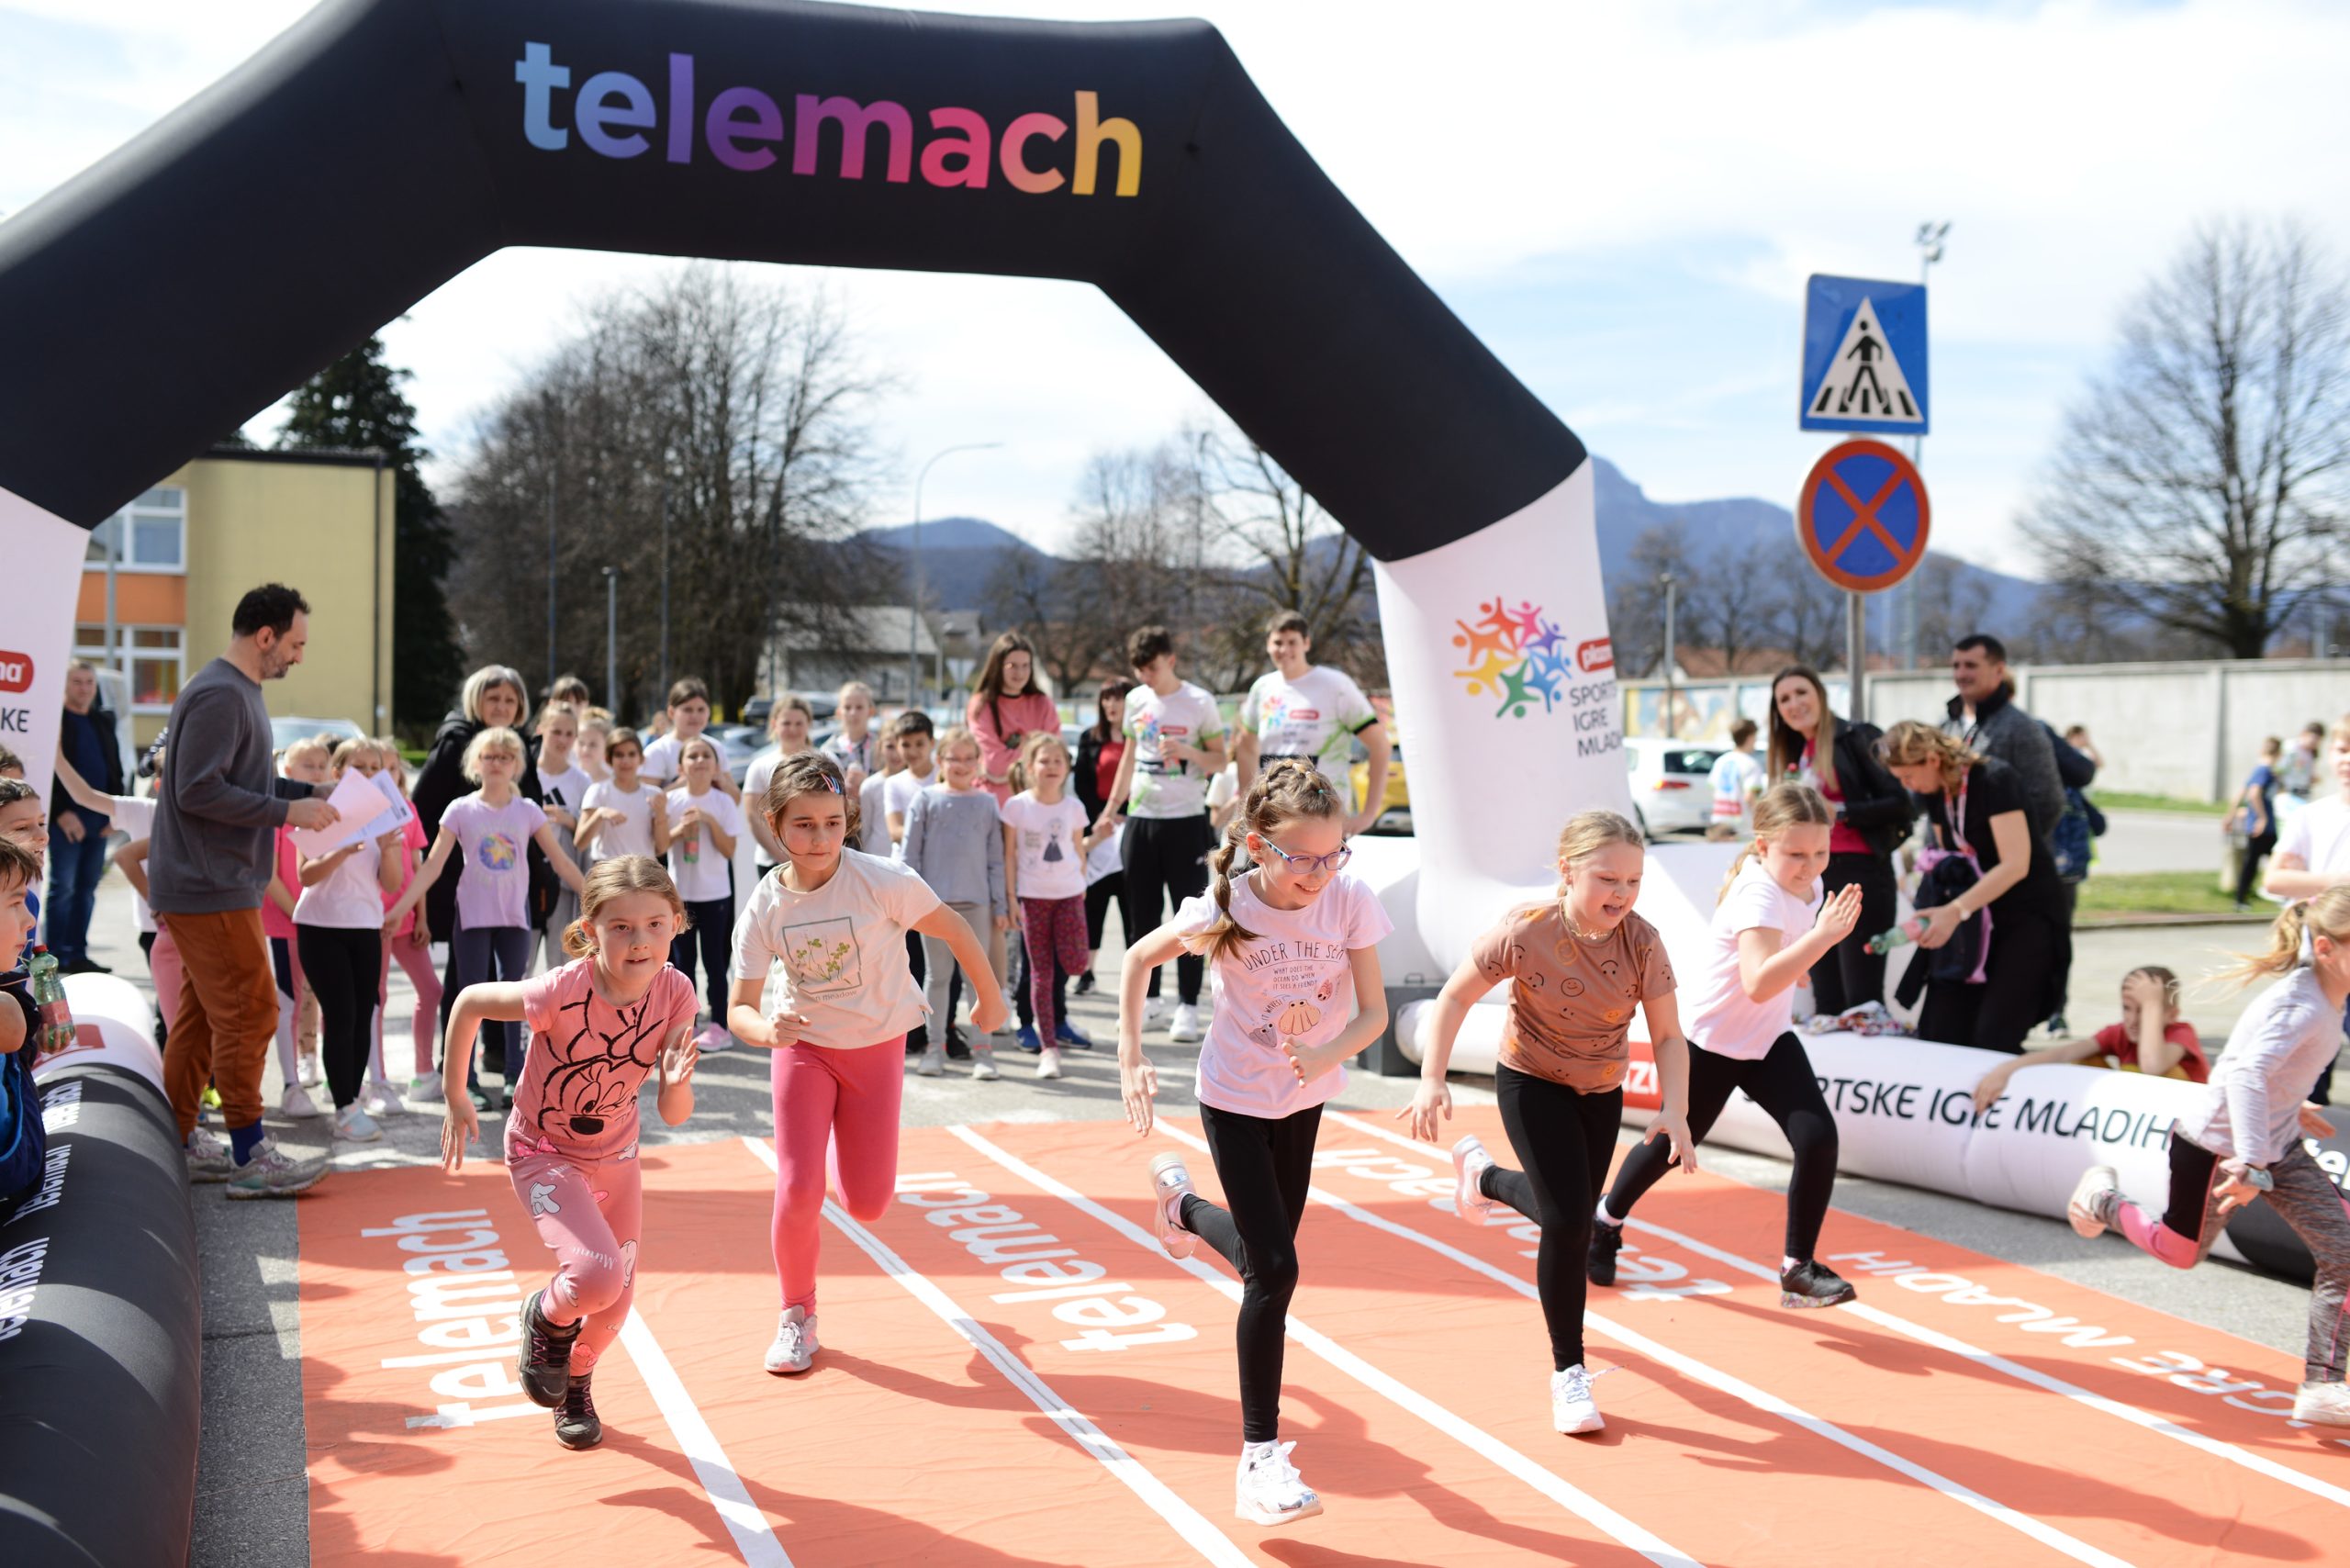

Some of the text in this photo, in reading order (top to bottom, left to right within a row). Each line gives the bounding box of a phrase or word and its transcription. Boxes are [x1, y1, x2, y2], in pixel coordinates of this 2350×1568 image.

[515, 41, 1143, 197] telemach
[1572, 708, 1608, 732] IGRE
[1242, 942, 1288, 970] UNDER
[1294, 941, 1321, 958] THE
[822, 990, 857, 1002] meadow
[1929, 1088, 2010, 1129] IGE
[2015, 1097, 2179, 1151] MLADIH
[361, 1208, 553, 1429] telemach
[1827, 1251, 2313, 1428] GRE MLADIH
